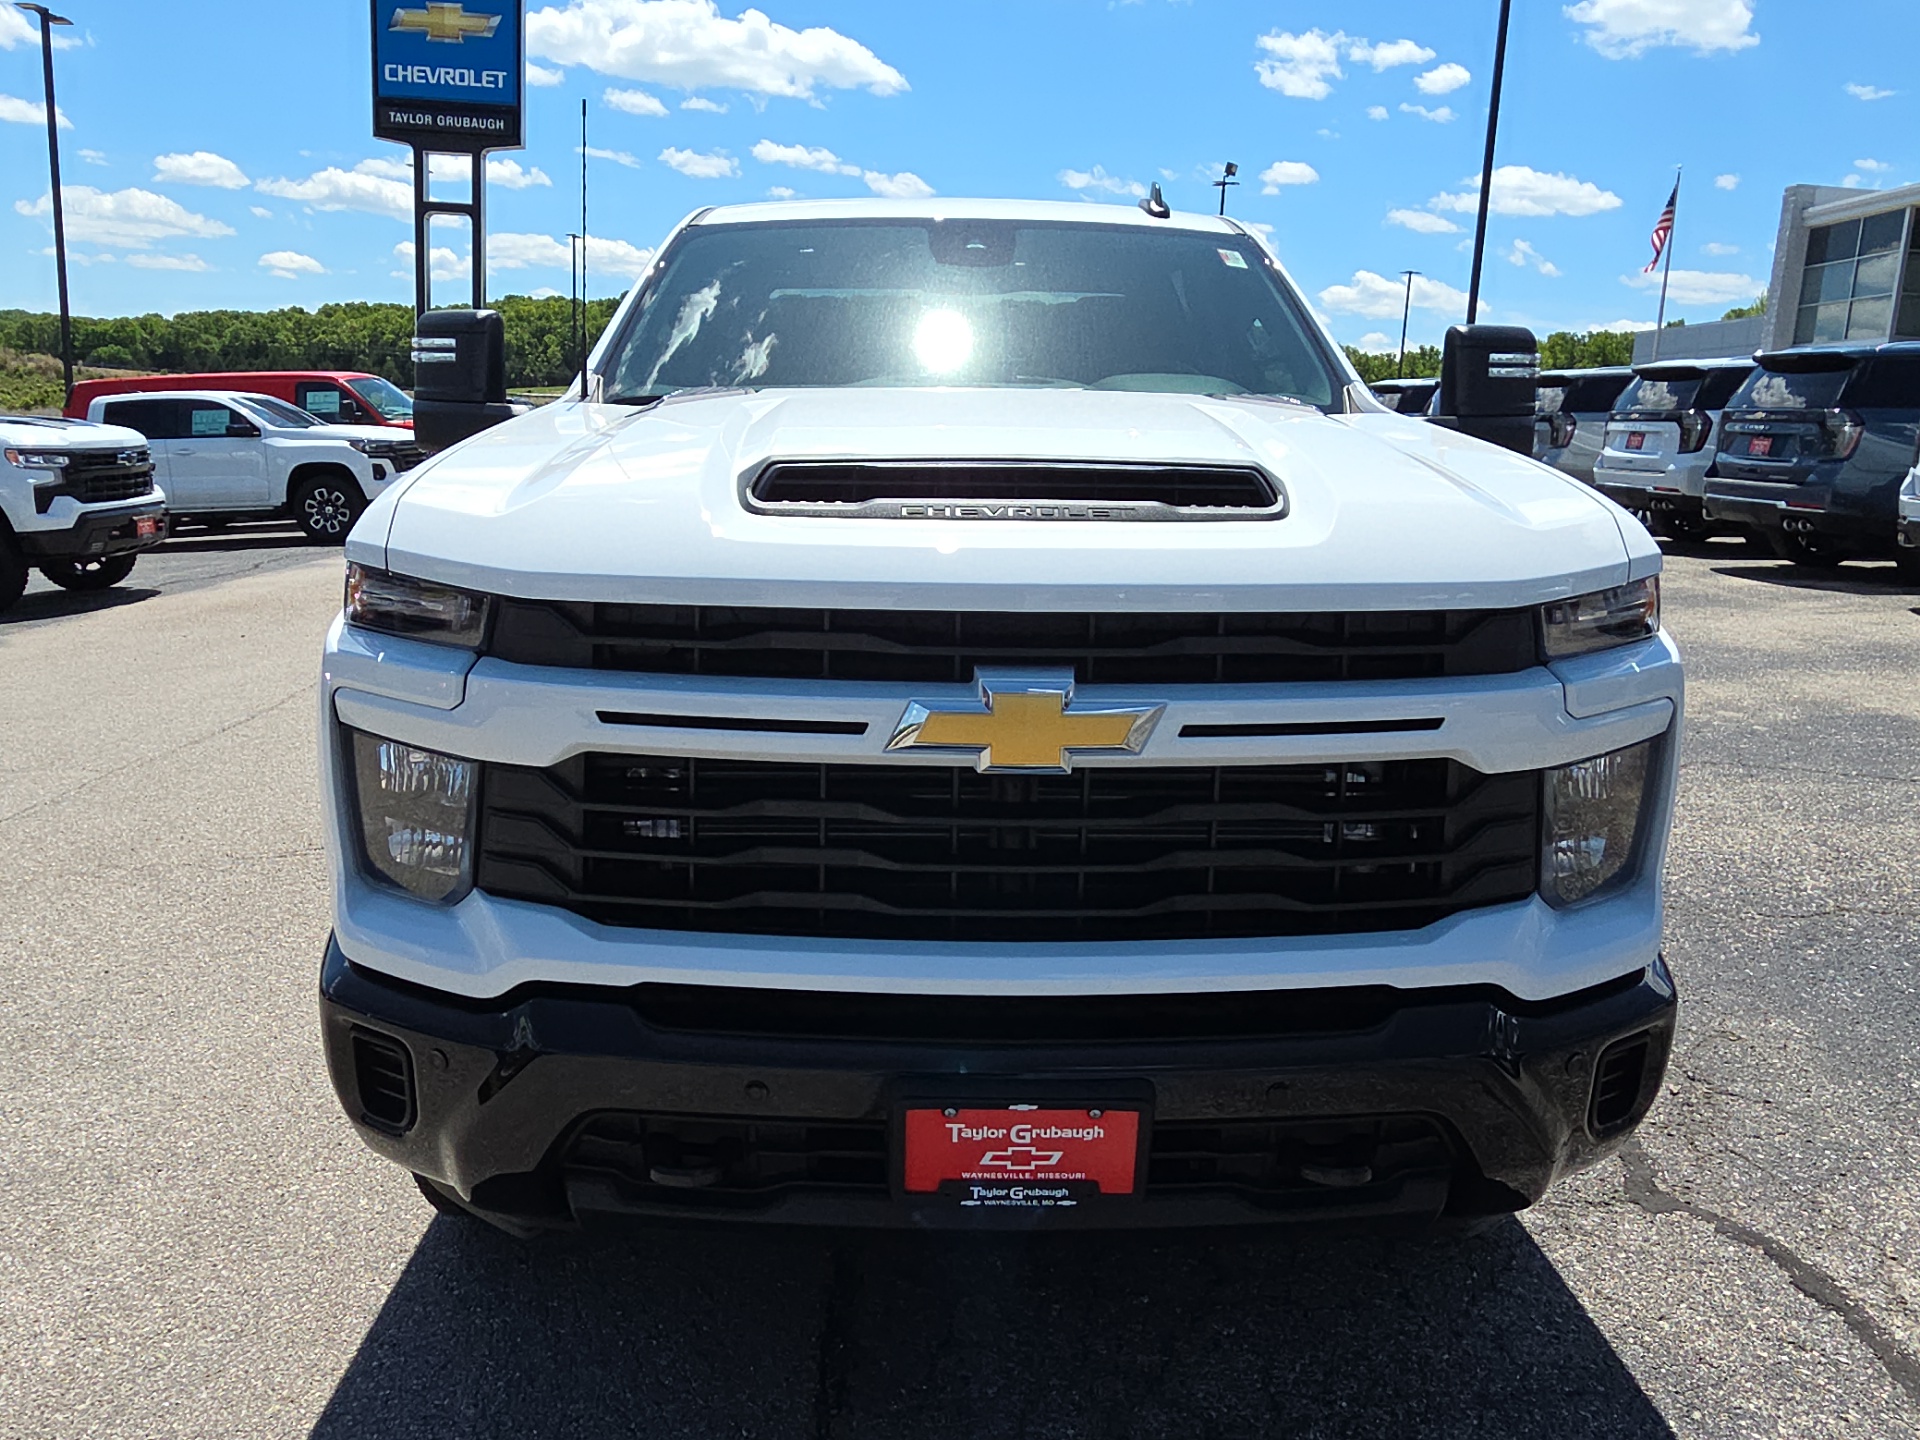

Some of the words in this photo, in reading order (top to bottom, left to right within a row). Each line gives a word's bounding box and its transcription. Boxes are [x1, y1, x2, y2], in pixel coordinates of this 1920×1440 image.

[384, 64, 507, 89] CHEVROLET
[388, 111, 433, 125] TAYLOR
[437, 115, 504, 130] GRUBAUGH
[901, 505, 1136, 518] CHEVROLET
[945, 1123, 1007, 1143] Taylor
[1010, 1124, 1104, 1144] Grubaugh
[961, 1172, 1034, 1180] WAYNESVILLE,
[969, 1186, 1009, 1200] Taylor
[1009, 1186, 1069, 1200] Grubaugh
